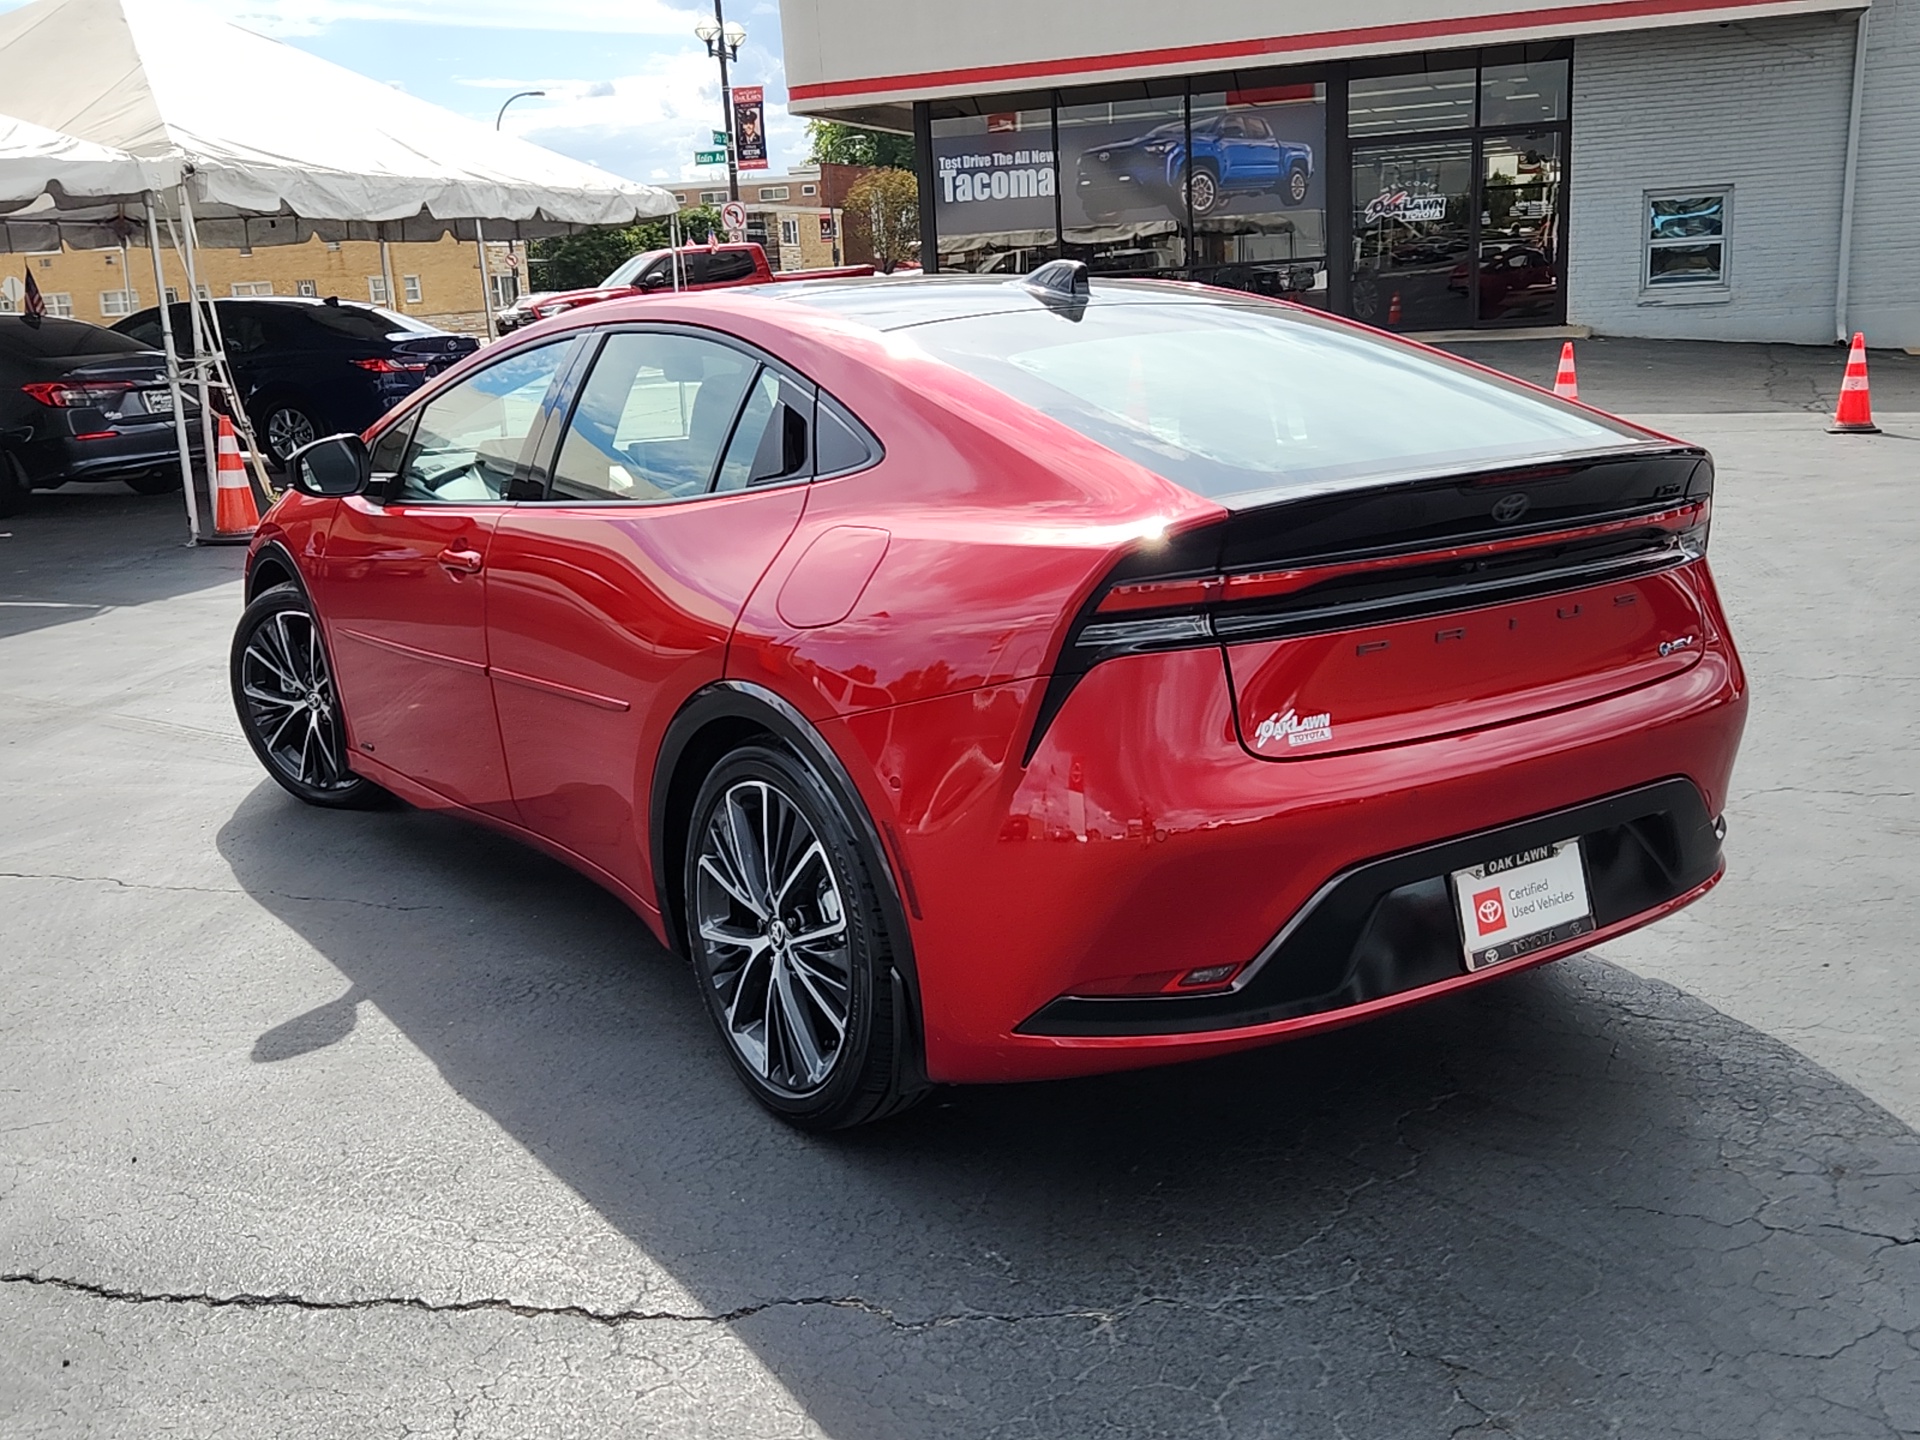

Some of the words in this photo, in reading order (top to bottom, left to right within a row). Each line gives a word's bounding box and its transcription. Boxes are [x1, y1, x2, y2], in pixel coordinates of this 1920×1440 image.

[697, 153, 714, 163] Kolin
[939, 157, 962, 170] Test
[962, 155, 992, 168] Drive
[992, 153, 1013, 166] The
[1014, 150, 1030, 165] All
[1031, 150, 1054, 163] New
[939, 167, 1056, 203] Tacoma
[1380, 180, 1438, 192] WELCOME
[1404, 210, 1442, 219] TOYOTA
[1356, 592, 1638, 657] PRIUS
[1293, 730, 1326, 742] TOYOTA
[1488, 854, 1514, 873] OAK
[1516, 846, 1548, 865] LAWN
[1508, 878, 1549, 901] Certified
[1511, 900, 1536, 918] Used
[1536, 891, 1575, 910] Vehicles
[1509, 930, 1557, 954] TOYOTA
